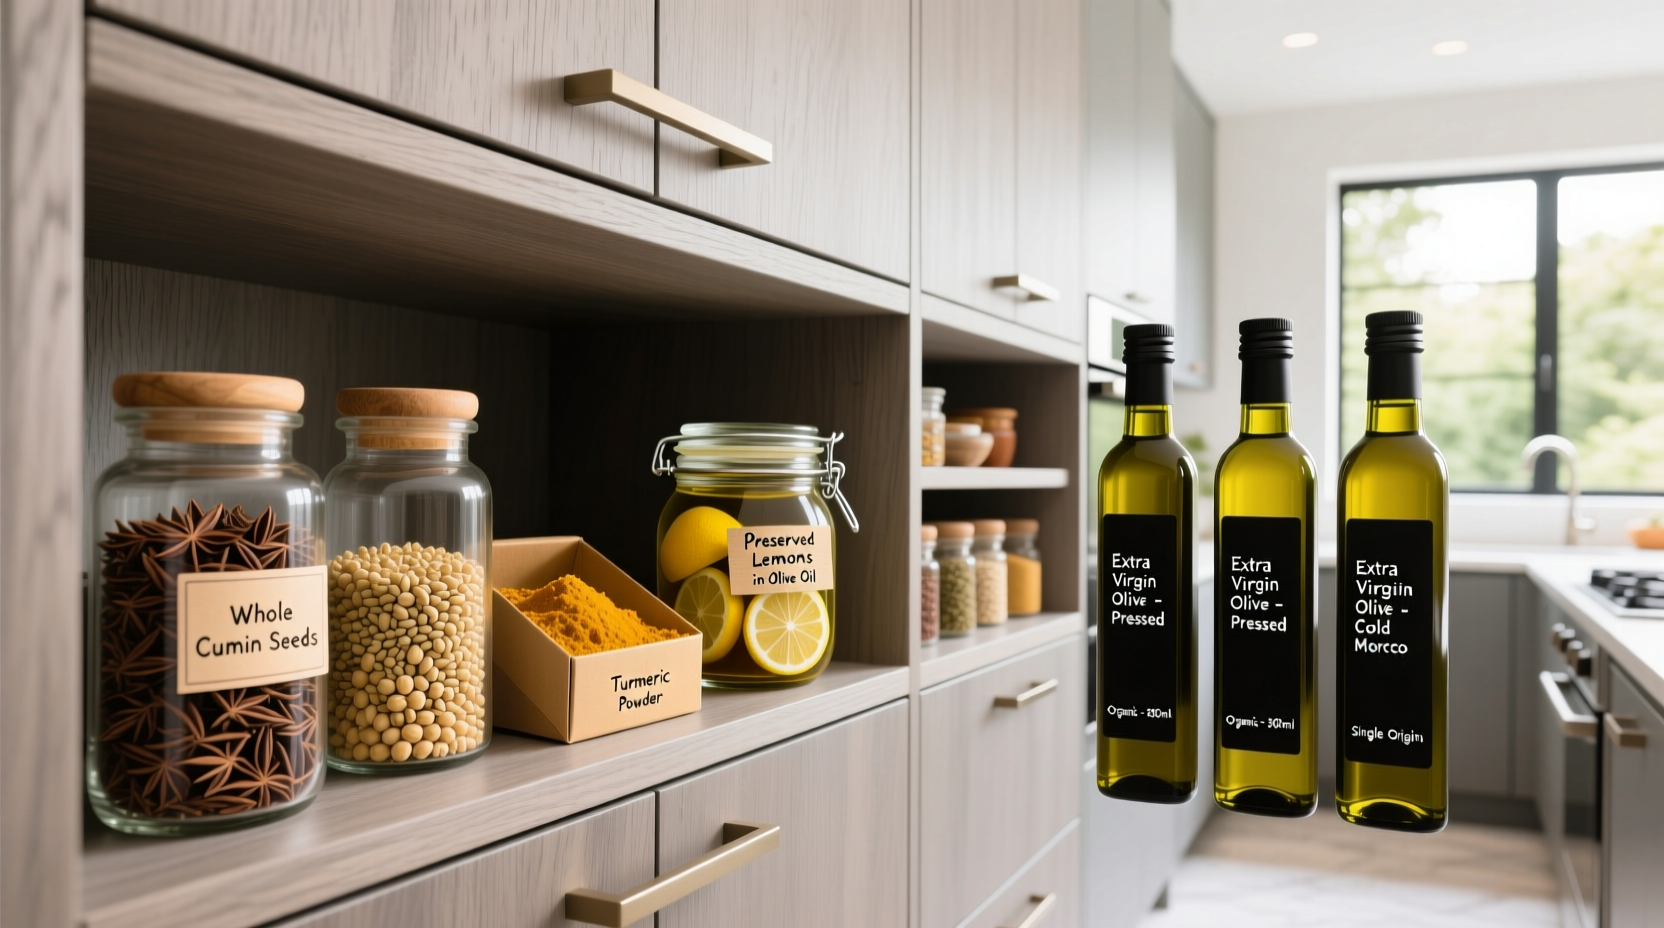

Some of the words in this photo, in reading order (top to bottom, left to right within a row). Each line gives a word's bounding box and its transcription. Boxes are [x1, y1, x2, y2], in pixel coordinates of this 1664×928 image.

[745, 532, 814, 550] Preserved
[753, 553, 812, 567] Lemons
[1113, 553, 1150, 569] Extra
[1232, 556, 1271, 572] Extra
[1357, 560, 1397, 576] Extra
[753, 574, 764, 585] in
[769, 571, 796, 584] Olive
[801, 570, 815, 582] Oil
[1113, 573, 1156, 591] Virgin
[1232, 576, 1278, 594] Virgin
[1112, 590, 1146, 606] Olive
[1231, 595, 1269, 610] Olive
[230, 601, 292, 625] Whole
[1356, 599, 1393, 615] Olive
[1112, 611, 1164, 626] Pressed
[1232, 615, 1286, 632] Pressed
[1355, 619, 1390, 634] Cold
[196, 636, 261, 657] Cumin
[270, 627, 317, 650] Seeds
[1355, 638, 1408, 654] Morcco
[611, 669, 670, 692] Turmeric
[619, 691, 663, 711] Powder
